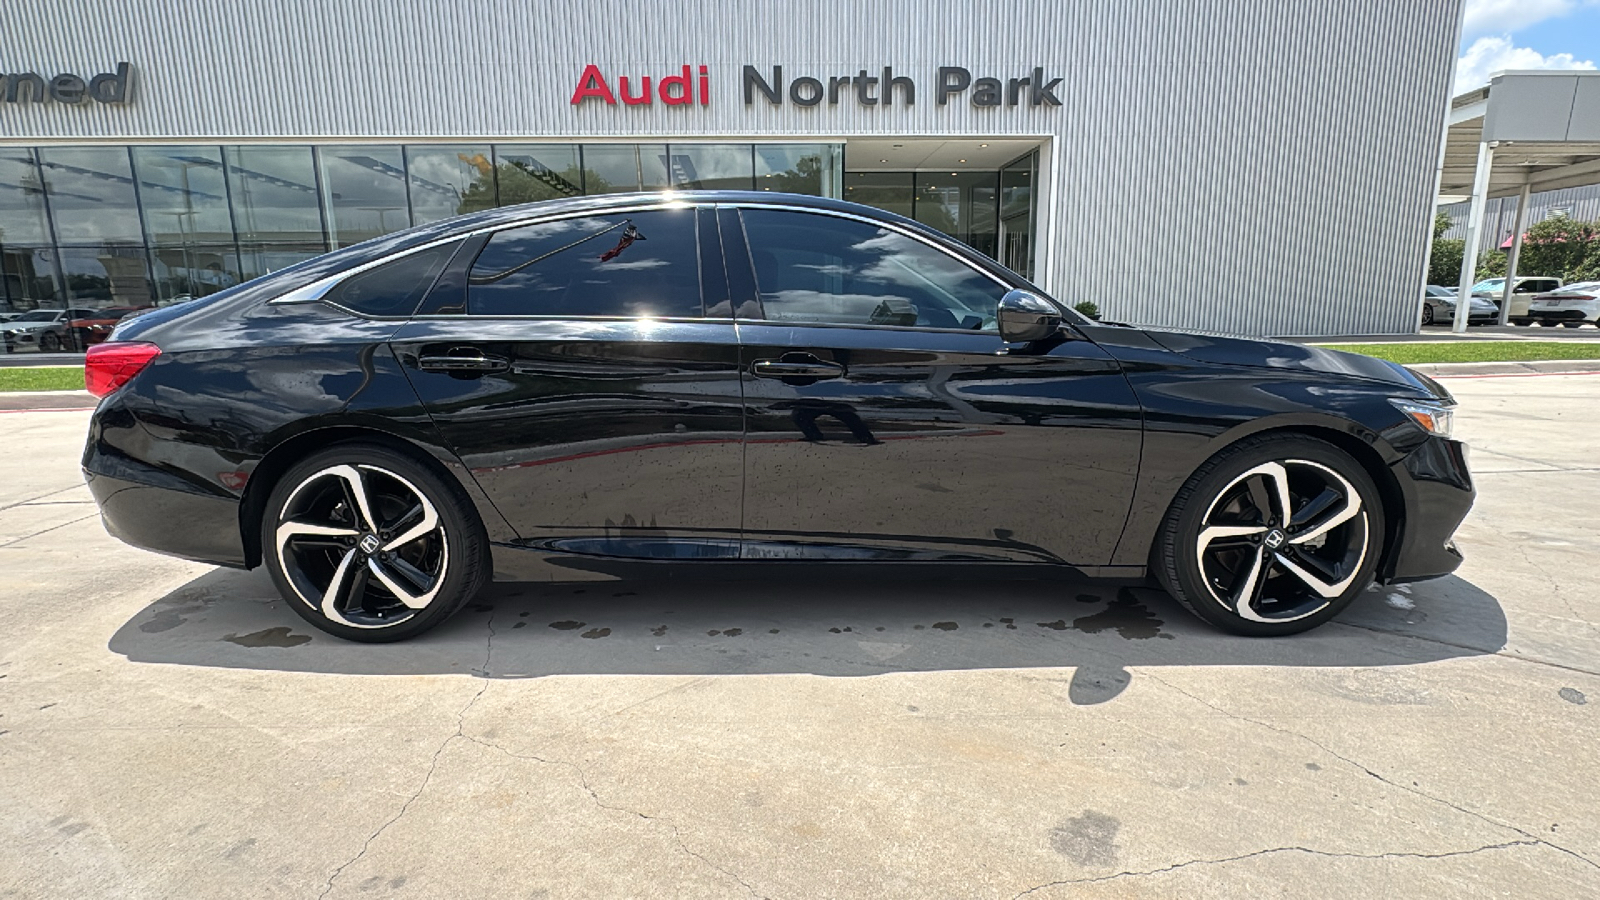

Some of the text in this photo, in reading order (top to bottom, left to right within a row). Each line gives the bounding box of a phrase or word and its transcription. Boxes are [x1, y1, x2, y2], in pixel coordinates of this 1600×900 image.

[0, 61, 134, 104] ned
[570, 64, 1063, 107] Audi North Park
